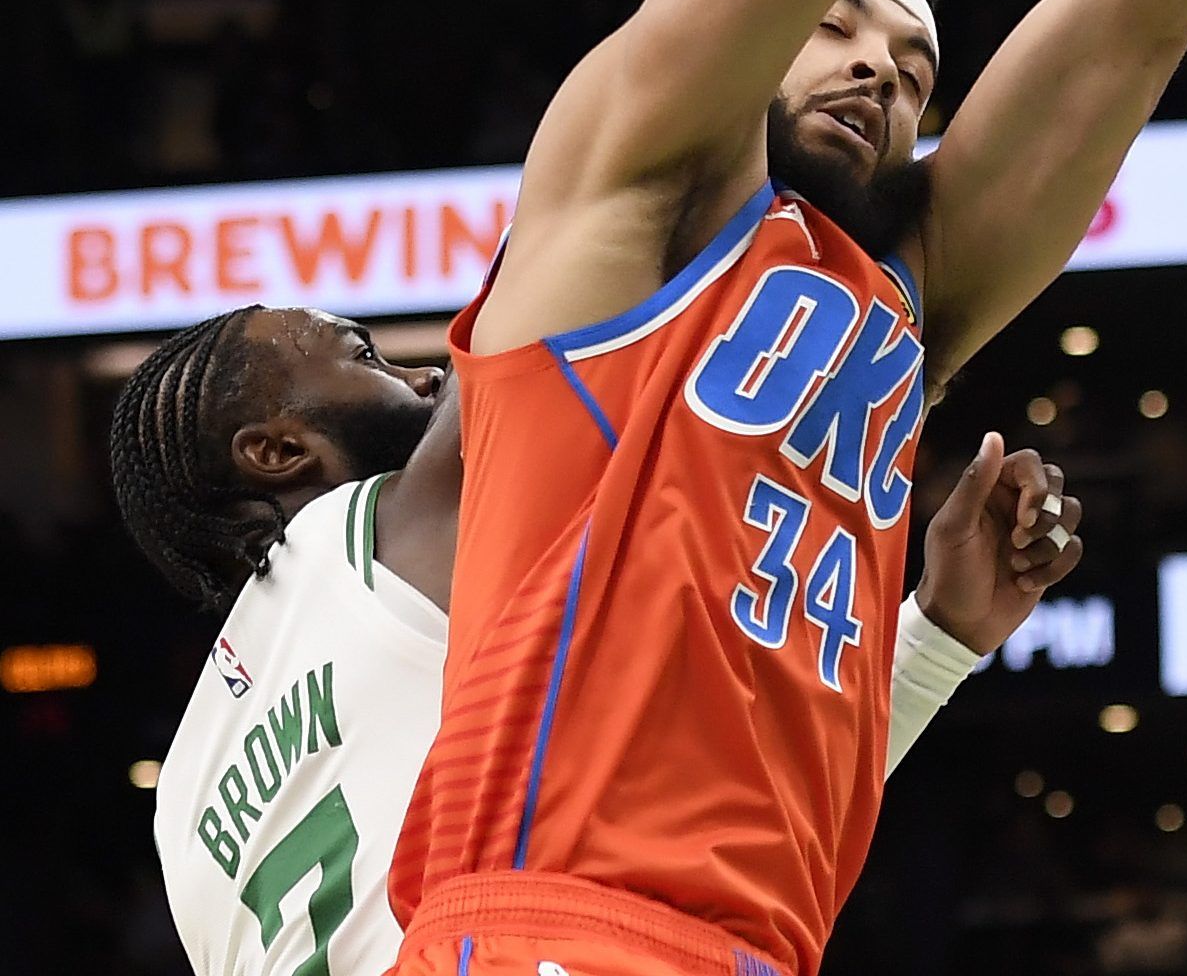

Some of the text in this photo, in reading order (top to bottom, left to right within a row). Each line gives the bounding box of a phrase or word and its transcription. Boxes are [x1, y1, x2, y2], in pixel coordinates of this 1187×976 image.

[67, 196, 508, 304] BREWIN
[684, 264, 925, 531] OKC
[730, 472, 862, 694] 34
[197, 661, 343, 880] BROWN
[239, 782, 360, 976] 7
